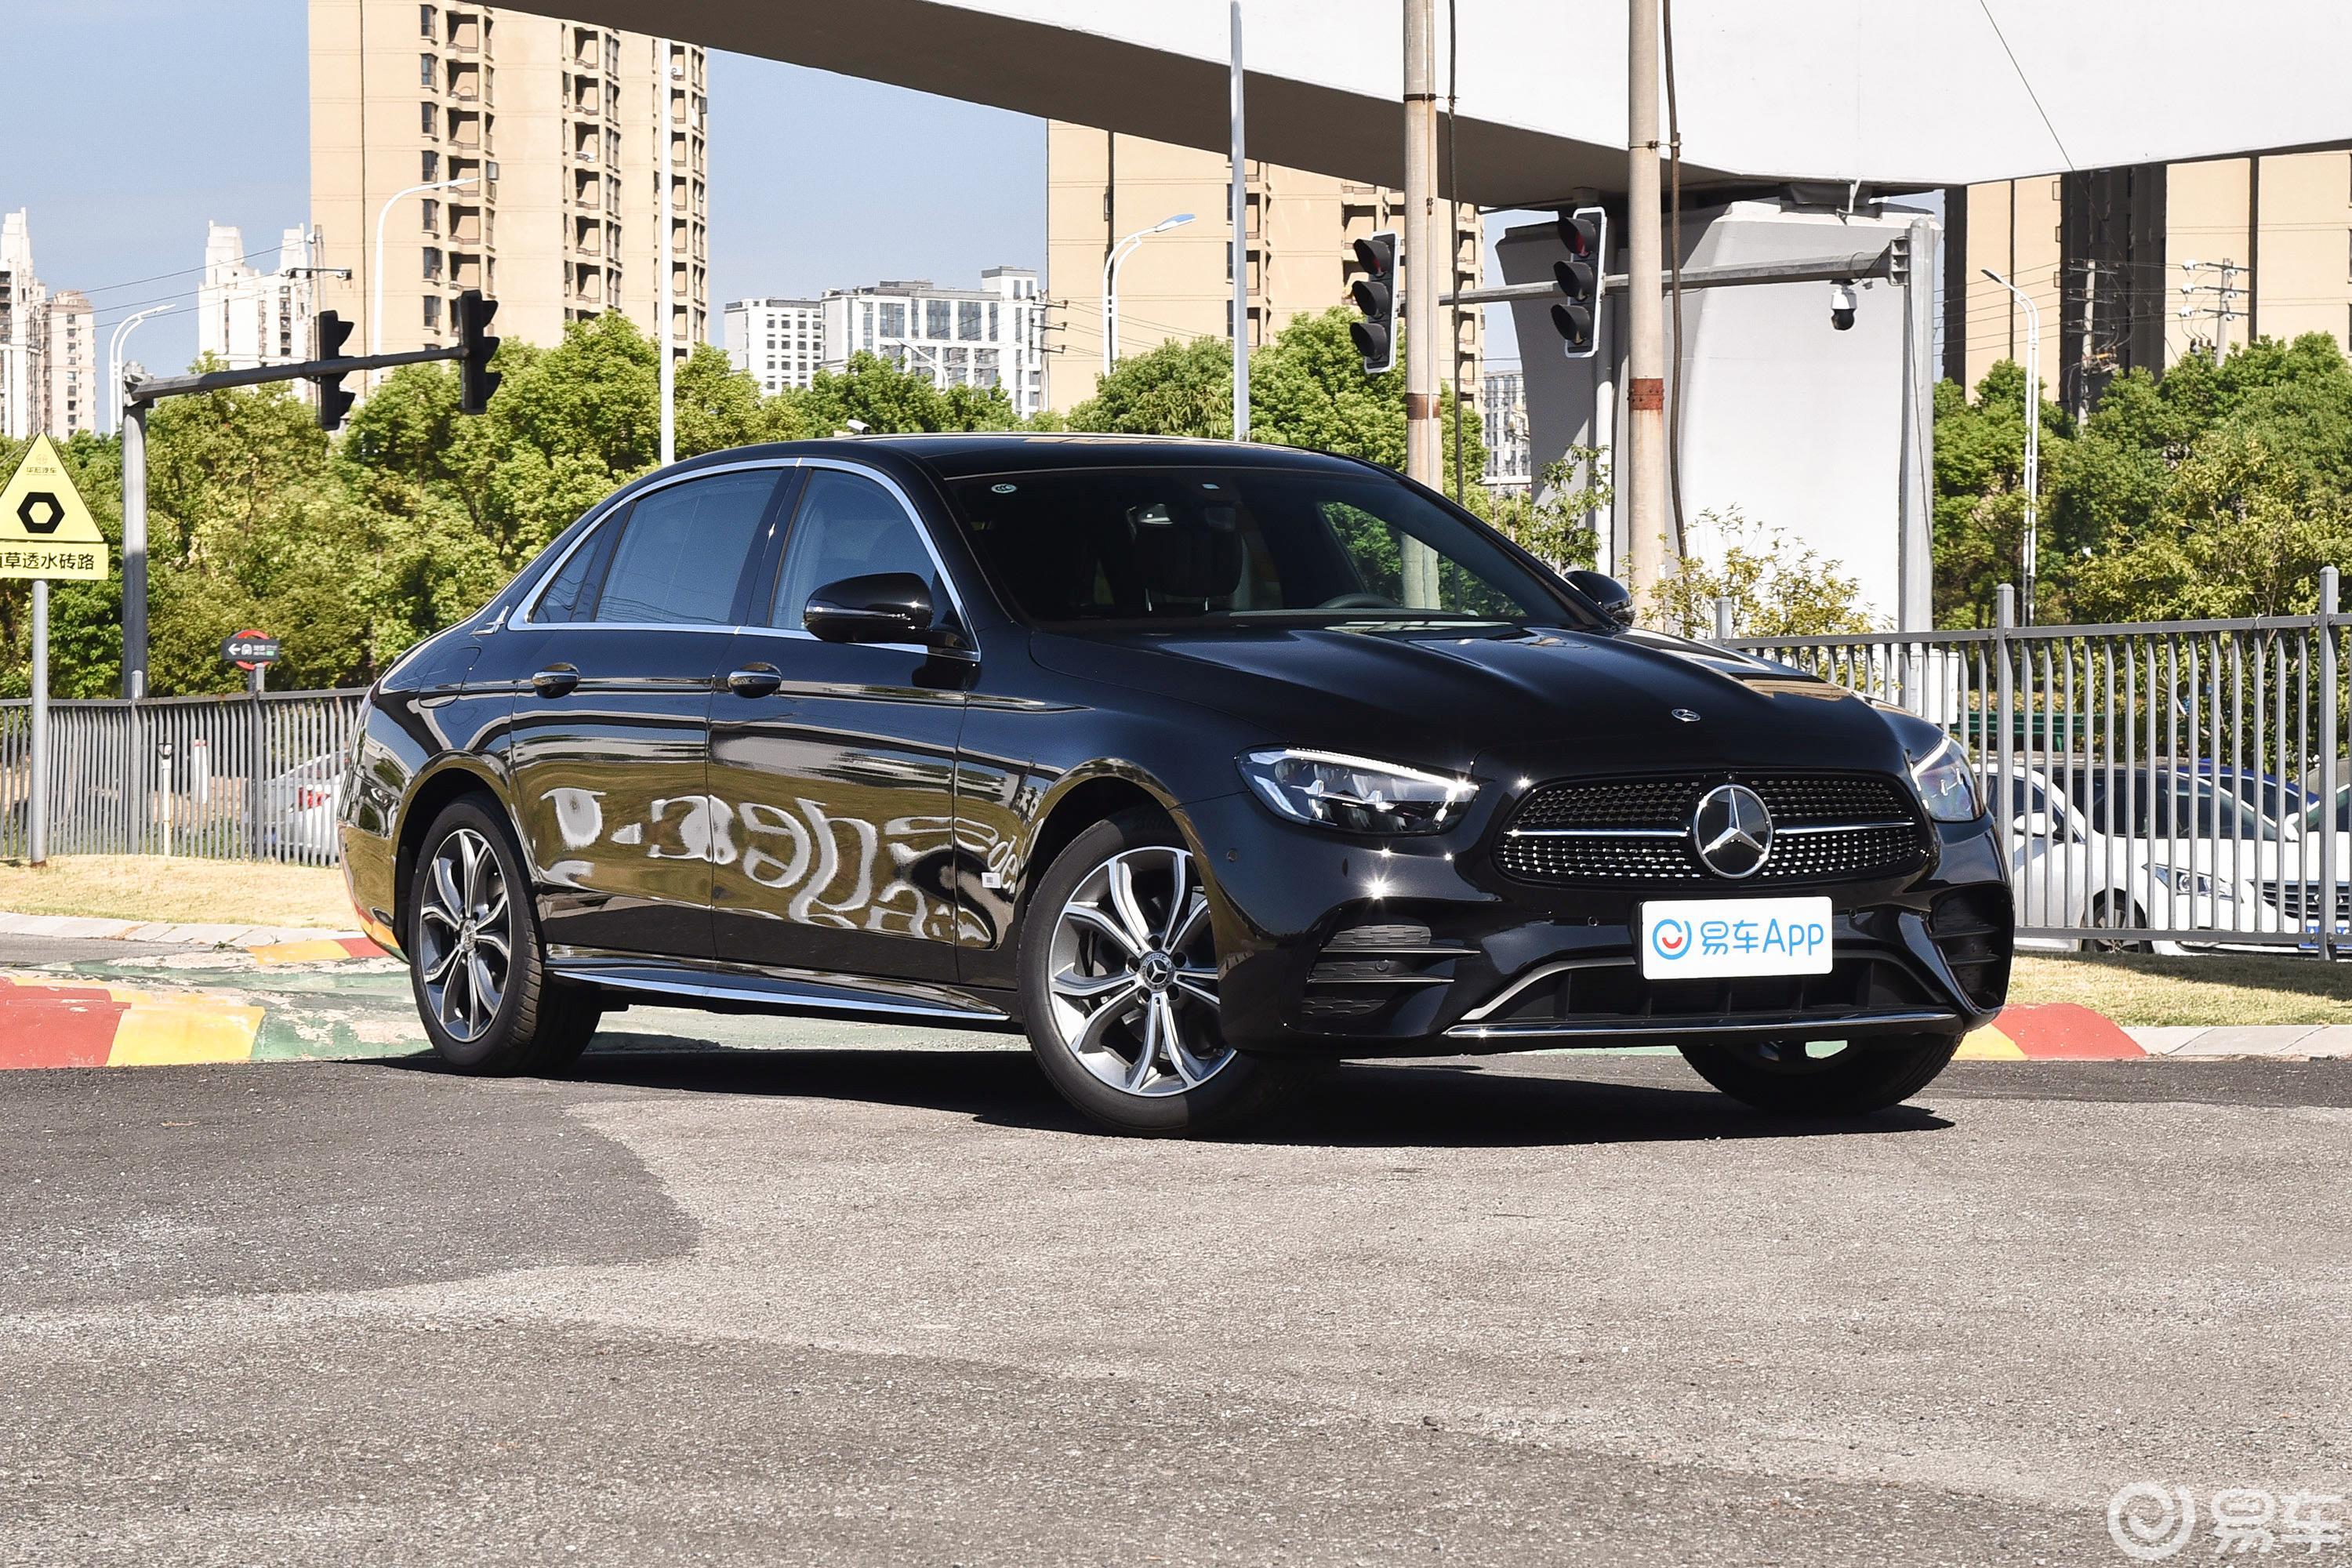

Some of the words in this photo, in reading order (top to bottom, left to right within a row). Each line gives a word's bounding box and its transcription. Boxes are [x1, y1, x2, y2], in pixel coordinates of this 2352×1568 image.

[0, 552, 94, 570] 草透水砖路
[1700, 918, 1824, 956] 易车App
